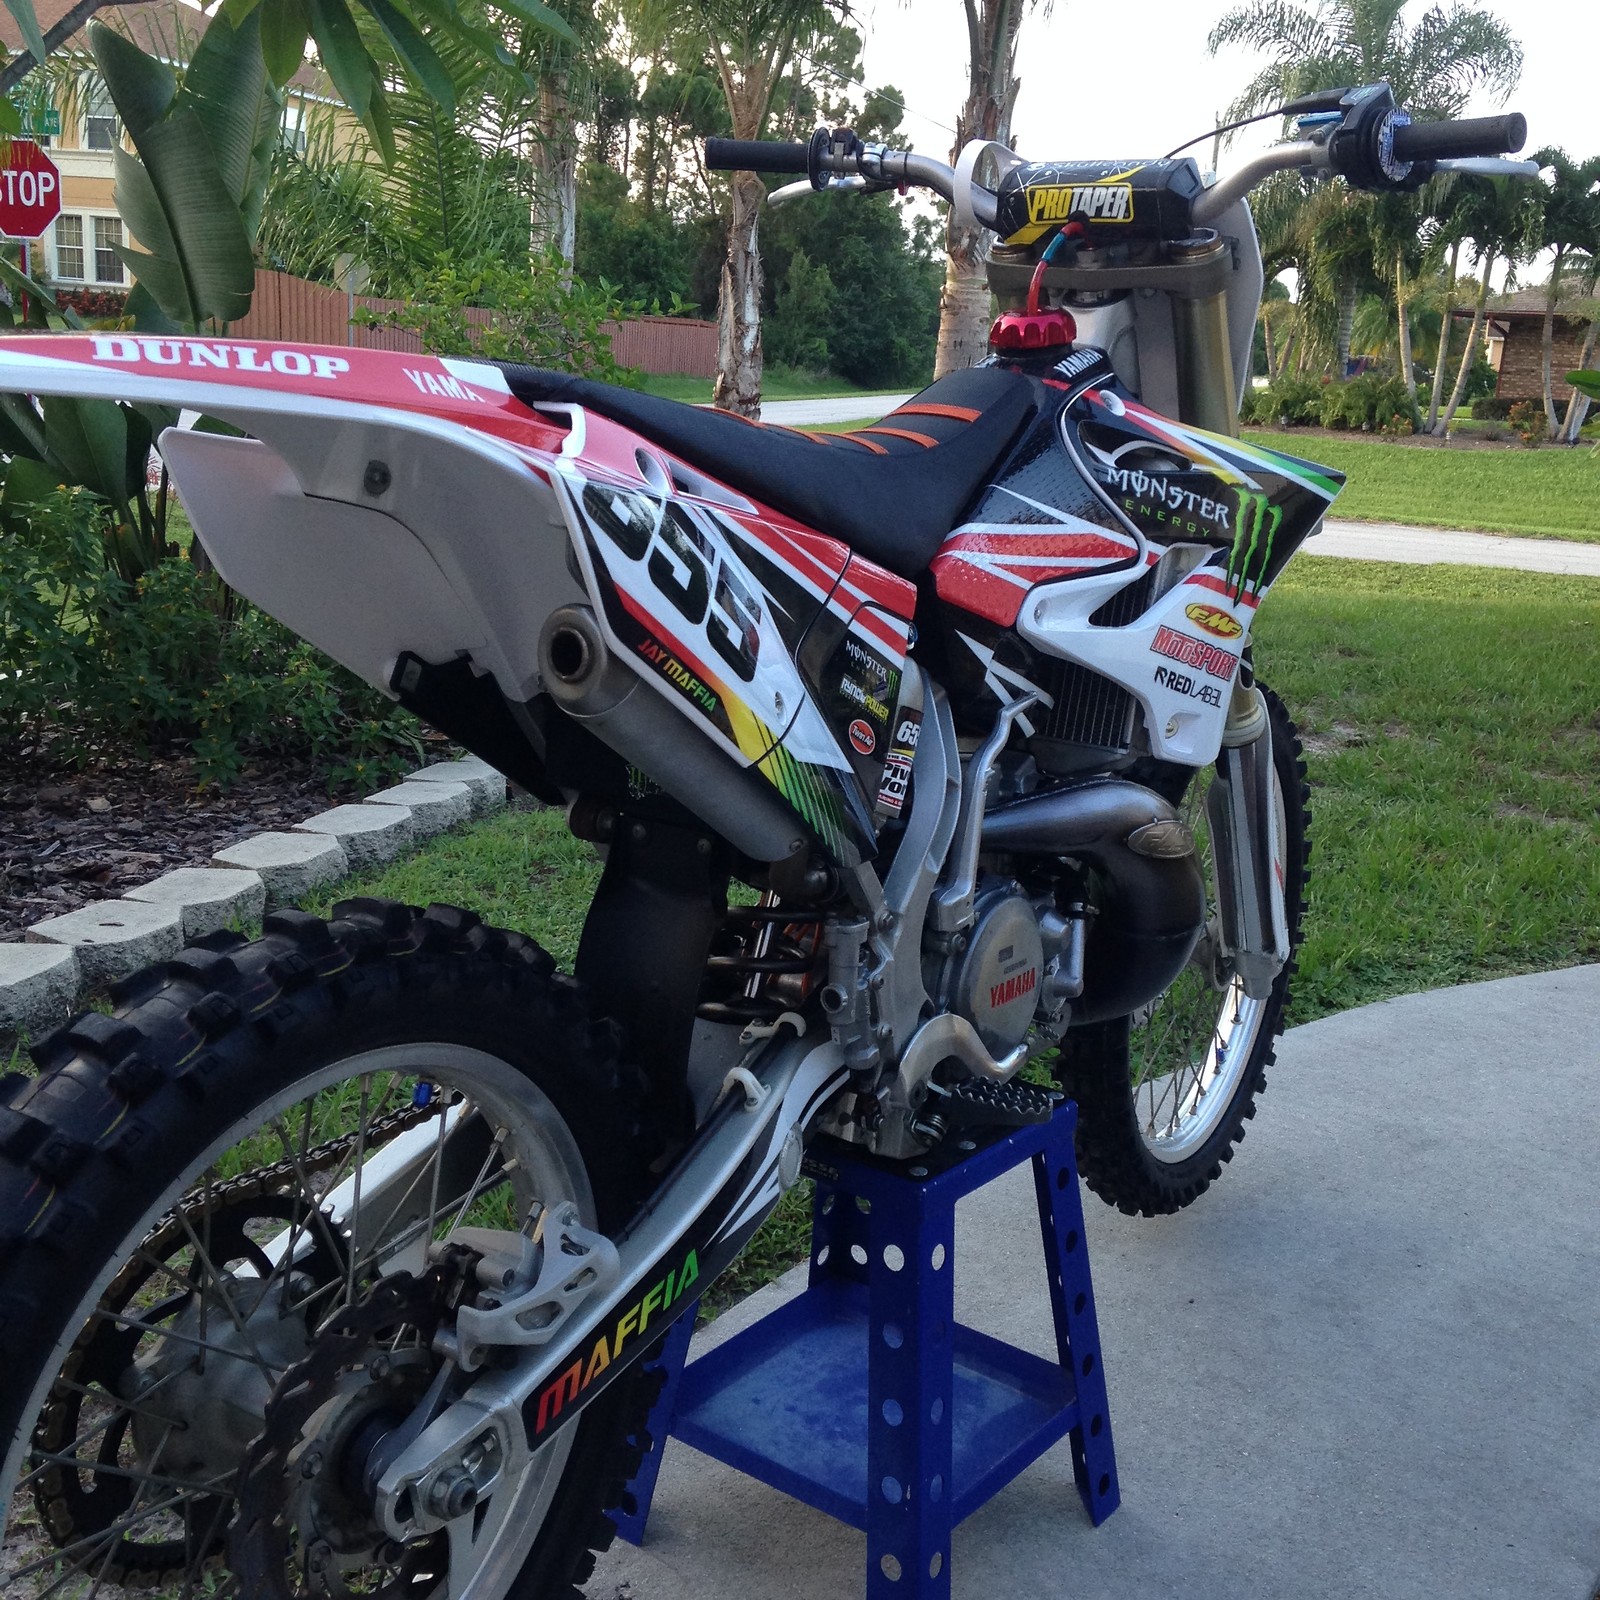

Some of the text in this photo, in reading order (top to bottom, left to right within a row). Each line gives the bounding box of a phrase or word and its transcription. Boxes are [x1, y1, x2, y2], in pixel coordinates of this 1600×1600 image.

[0, 170, 55, 207] TOP
[89, 337, 350, 379] DUNLOP
[1053, 348, 1103, 378] YAMAHA
[1107, 468, 1230, 529] MONSTER
[1125, 499, 1210, 537] ENERGY
[1187, 606, 1242, 634] FMF
[638, 638, 717, 712] JAY MAFFIA
[846, 640, 887, 682] MONSTER
[897, 720, 920, 747] 65
[991, 967, 1035, 1009] YAMAHA
[535, 1248, 700, 1435] MAFFIA
